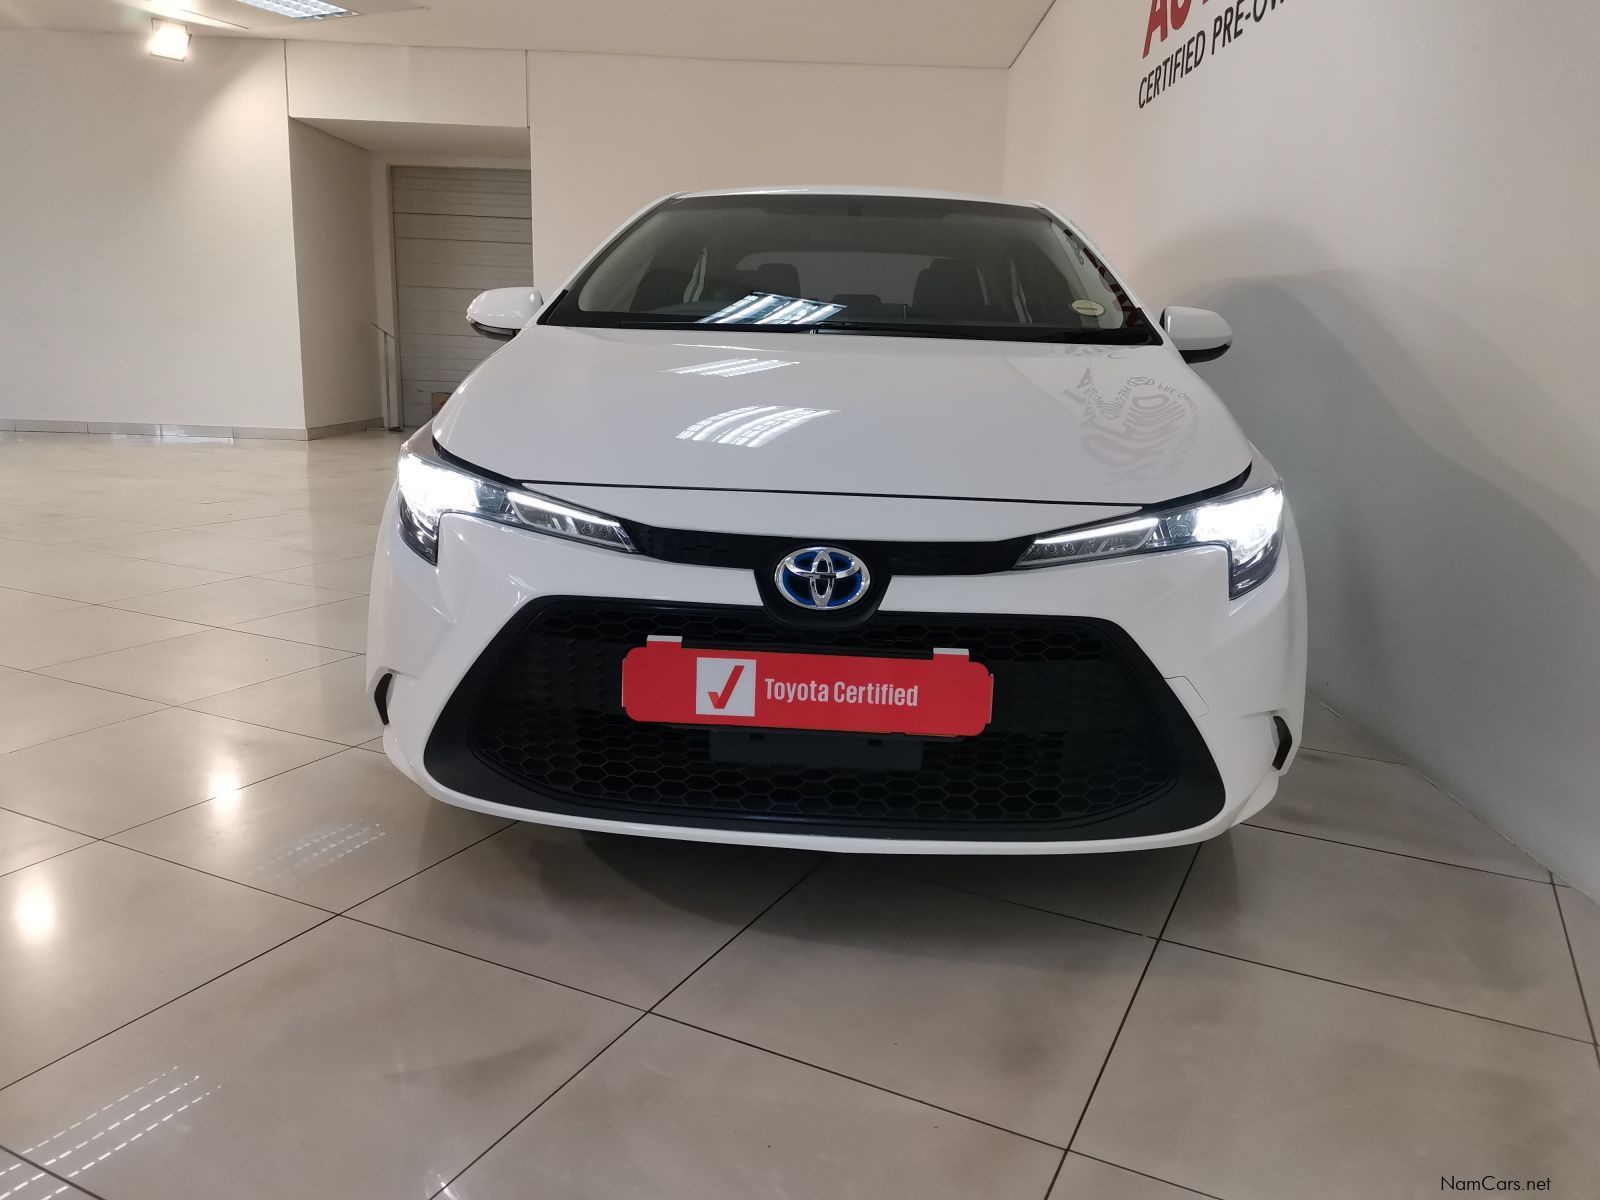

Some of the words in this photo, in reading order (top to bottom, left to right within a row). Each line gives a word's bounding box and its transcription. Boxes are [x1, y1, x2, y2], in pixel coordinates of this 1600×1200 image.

[1138, 30, 1206, 109] CERTIFIED
[764, 678, 829, 703] Toyota
[833, 681, 918, 707] Certified
